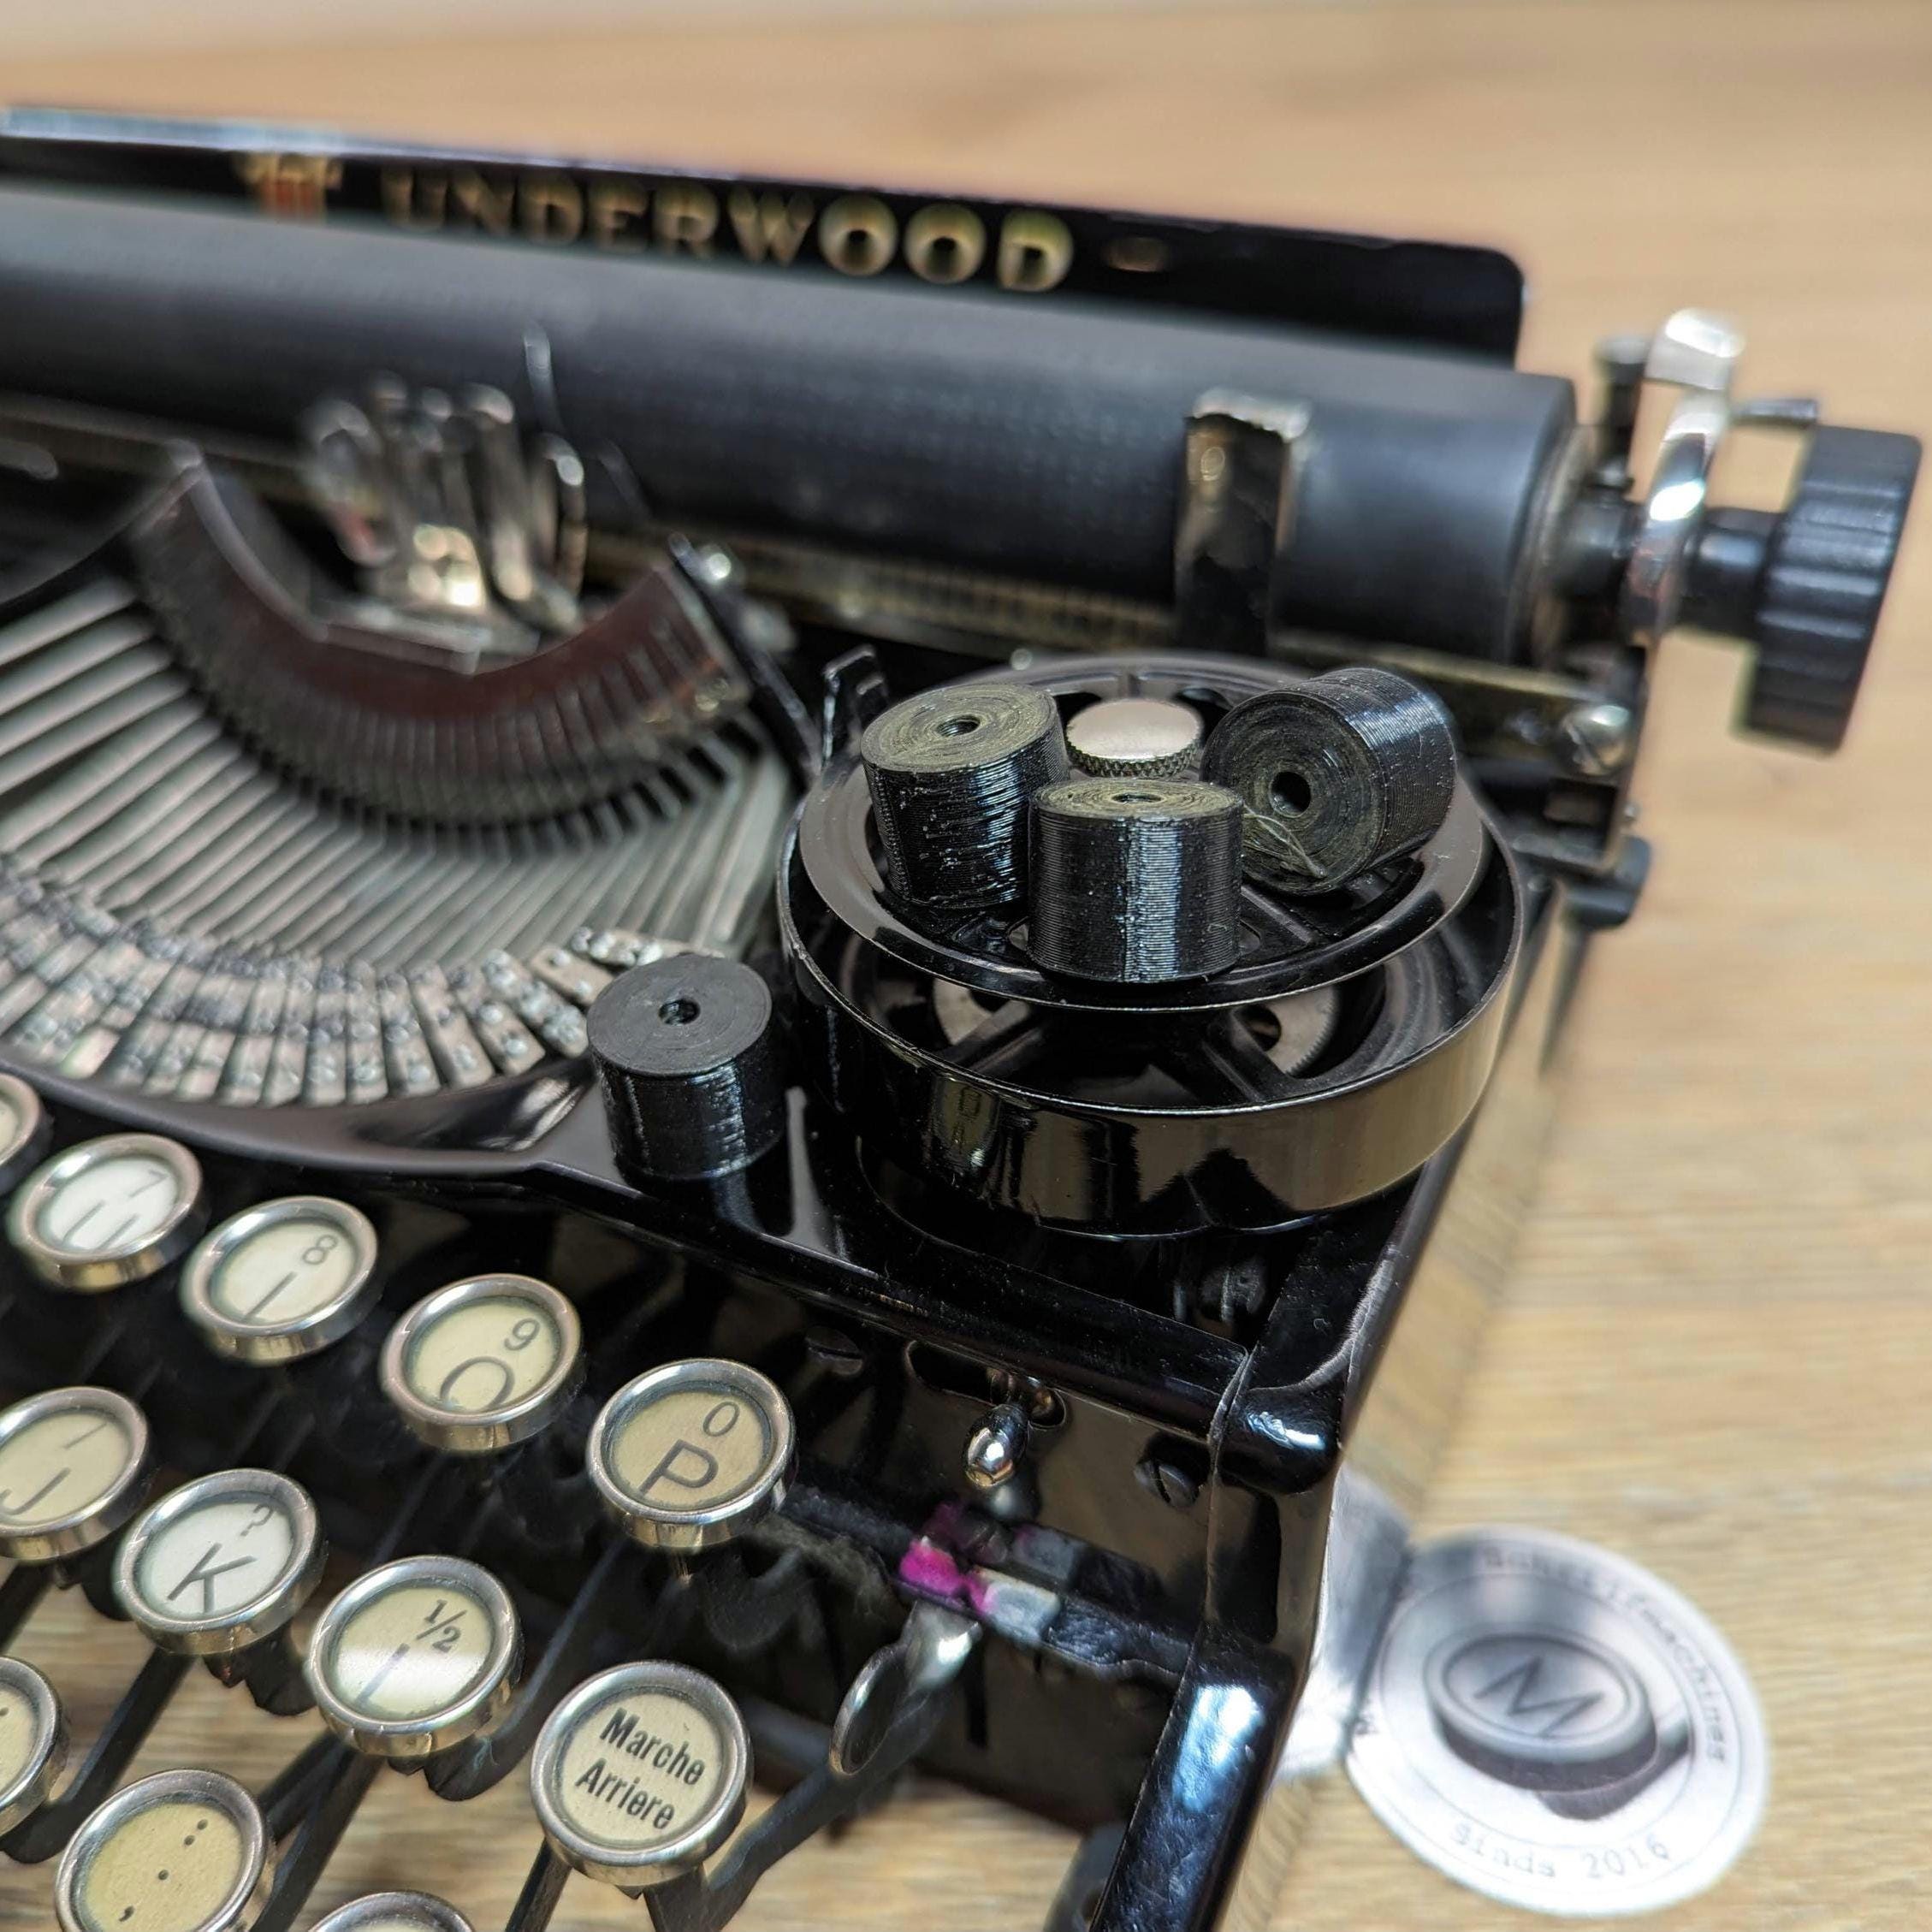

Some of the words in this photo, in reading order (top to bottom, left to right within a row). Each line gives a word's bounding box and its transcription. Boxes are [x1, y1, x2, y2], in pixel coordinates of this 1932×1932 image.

[381, 167, 1075, 293] UNDERWOOD
[303, 1235, 337, 1265] 8
[504, 1318, 541, 1352] 9
[639, 1438, 719, 1496] P
[167, 1542, 258, 1614] K
[599, 1708, 705, 1786] Marche
[574, 1757, 675, 1829] Arriere
[1582, 1833, 1670, 1879] 2016
